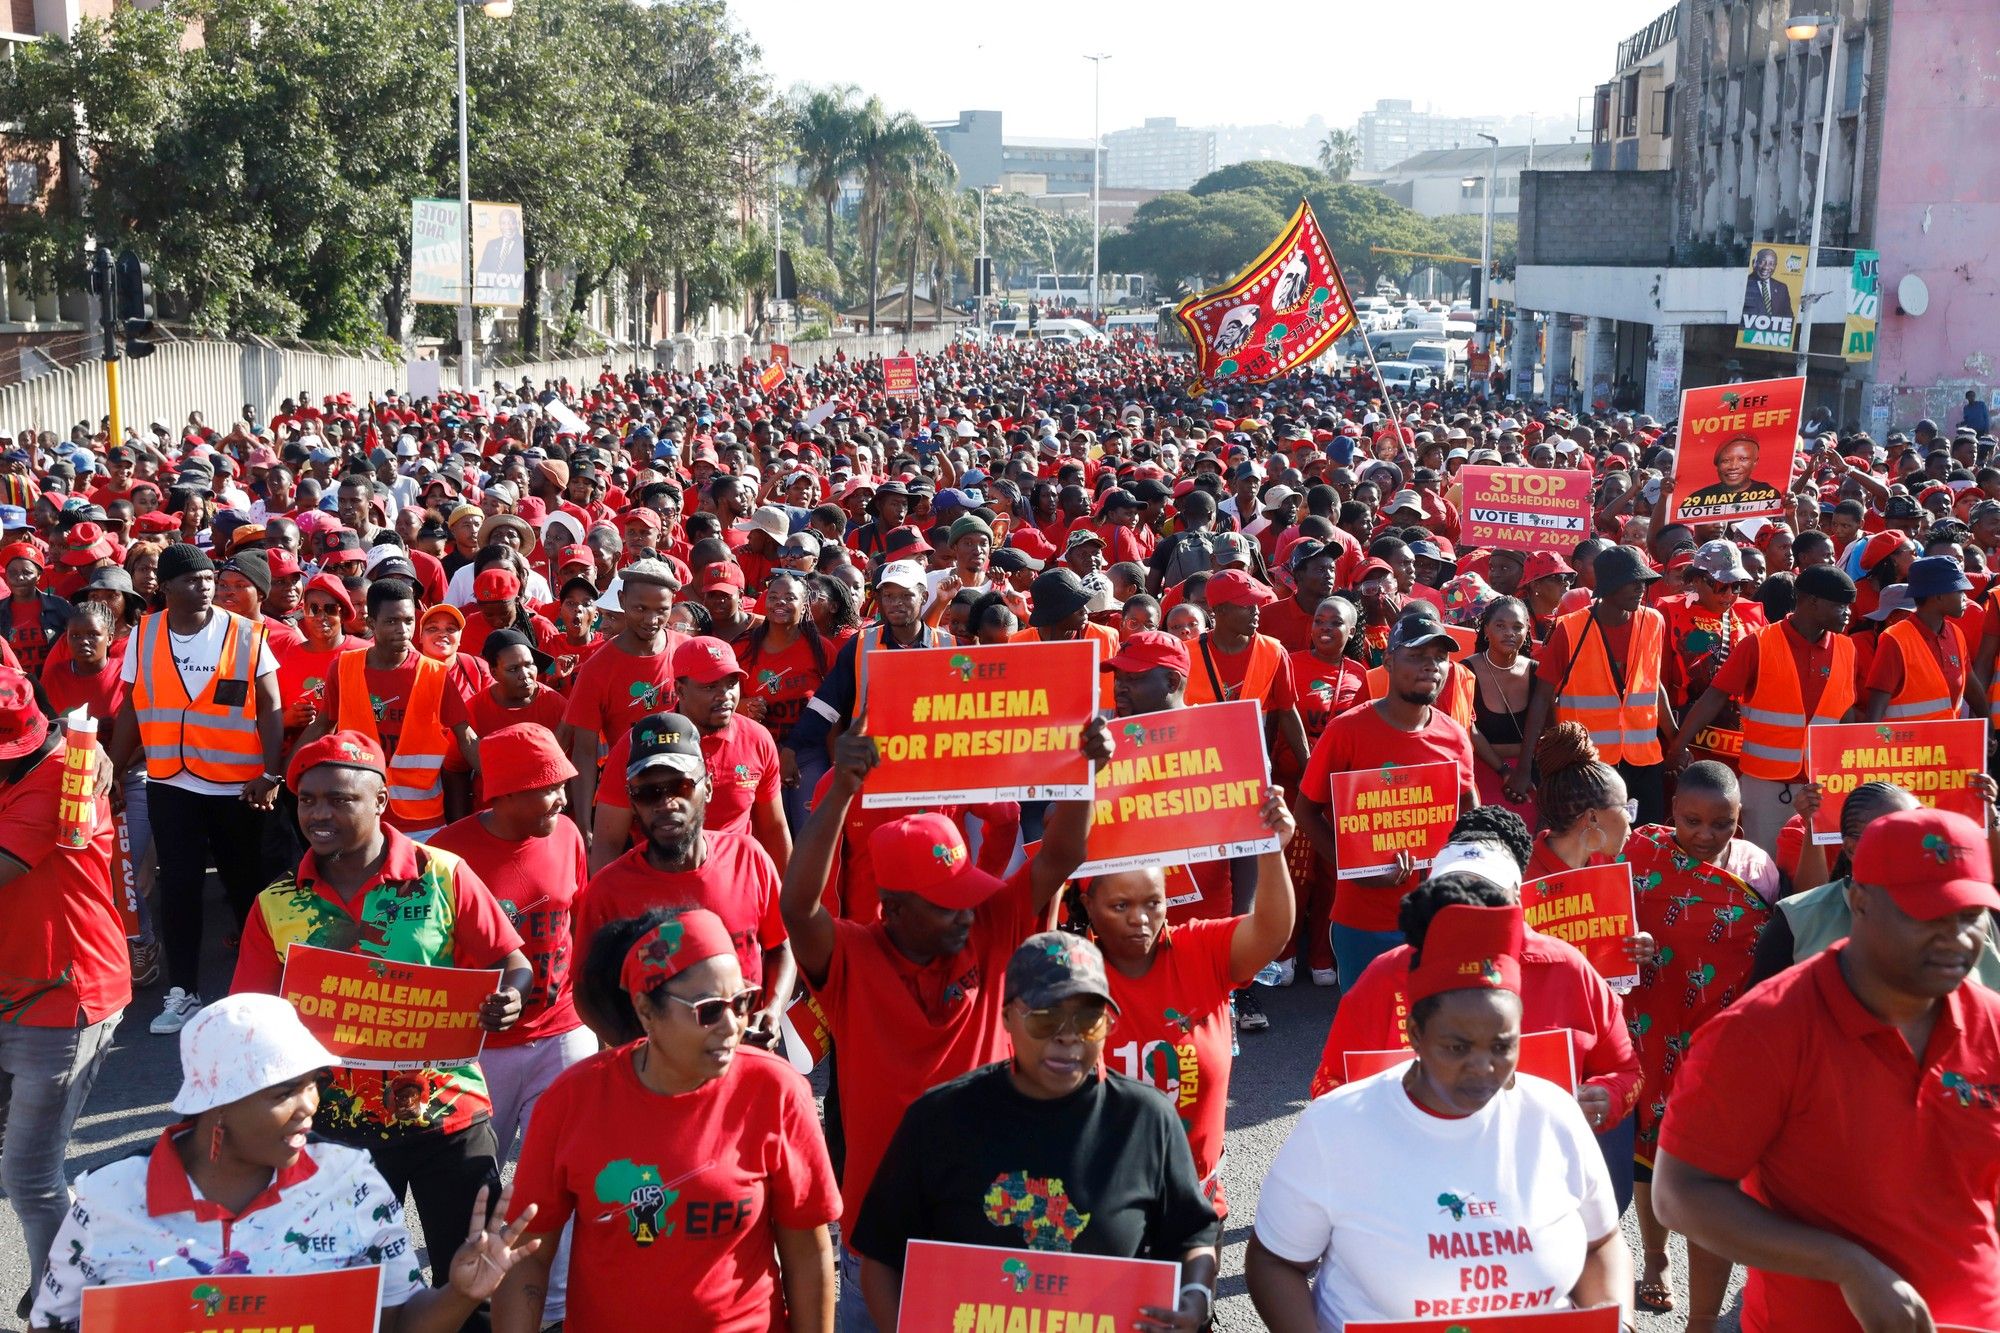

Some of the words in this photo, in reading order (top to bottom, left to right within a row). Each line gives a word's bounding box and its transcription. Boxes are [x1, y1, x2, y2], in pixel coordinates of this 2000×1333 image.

[1743, 314, 1793, 332] VOTE
[1750, 331, 1790, 347] ANC
[1743, 395, 1768, 408] EFF
[1691, 413, 1747, 435] VOTE
[1752, 408, 1791, 429] EFF
[1490, 473, 1566, 496] STOP
[1475, 491, 1579, 509] LOADSHEDDING!
[1683, 496, 1701, 507] 29
[1704, 493, 1737, 505] MAY
[1740, 489, 1775, 501] 2024
[1474, 509, 1518, 523] VOTE
[1681, 506, 1721, 518] VOTE
[1472, 526, 1493, 538] 29
[1498, 528, 1535, 542] MAY
[1540, 531, 1580, 546] 2024
[978, 663, 1006, 677] EFF
[912, 689, 1049, 722] #MALEMA
[658, 731, 680, 744] EFF
[873, 734, 927, 761] FOR
[934, 724, 1084, 758] PRESIDENT
[1150, 725, 1176, 742] EFF
[1695, 729, 1744, 753] VOTE
[361, 753, 376, 762] EFF
[1095, 747, 1223, 788] #MALEMA
[1841, 745, 1947, 768] #MALEMA
[1816, 774, 1858, 793] FOR
[868, 795, 903, 803] Economic
[937, 792, 966, 801] Fighters
[1000, 790, 1017, 798] VOTE
[1119, 780, 1261, 822] PRESIDENT
[1356, 786, 1433, 810] #MALEMA
[1340, 814, 1370, 834] FOR
[1373, 804, 1455, 830] PRESIDENT
[1372, 829, 1427, 852] MARCH
[1104, 860, 1132, 869] Freedom
[1134, 856, 1161, 866] Fighters
[1192, 850, 1208, 858] VOTE
[122, 859, 138, 913] 2024
[1549, 882, 1565, 893] EFF
[403, 904, 432, 919] EFF
[1524, 893, 1595, 927] MALEMA
[390, 969, 415, 981] EFF
[1458, 962, 1480, 975] EFF
[320, 975, 448, 1008] #MALEMA
[286, 992, 336, 1019] FOR
[342, 1001, 480, 1029] PRESIDENT
[333, 1024, 427, 1049] MARCH
[1113, 1040, 1180, 1105] 10
[1177, 1043, 1199, 1108] YEARS
[686, 1197, 753, 1235] EFF
[1468, 1201, 1497, 1216] EFF
[313, 1237, 336, 1252] EFF
[385, 1237, 406, 1260] EFF
[1427, 1226, 1533, 1260] MALEMA
[1035, 1274, 1069, 1292] EFF
[1460, 1265, 1508, 1292] FOR
[228, 1296, 267, 1312] EFF
[1415, 1286, 1556, 1317] PRESIDENT
[953, 1303, 1116, 1333] #MALEMA
